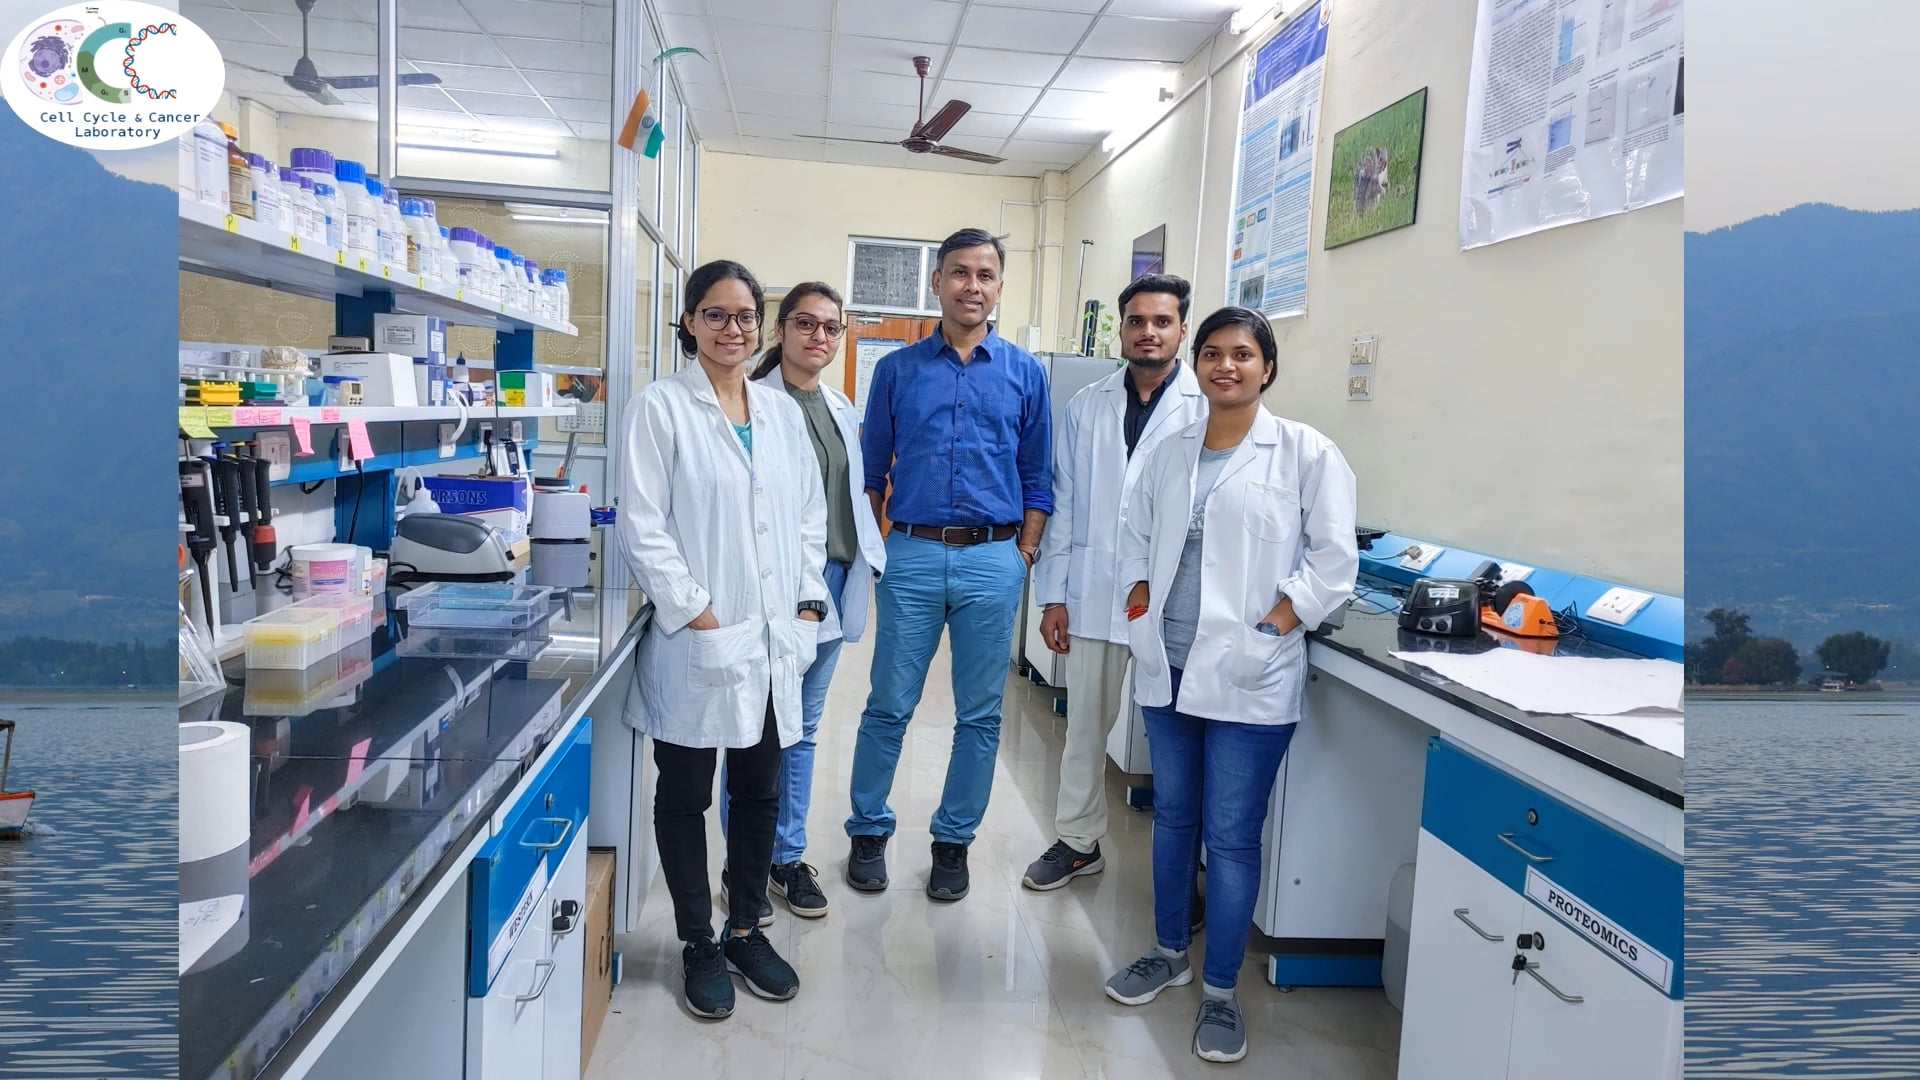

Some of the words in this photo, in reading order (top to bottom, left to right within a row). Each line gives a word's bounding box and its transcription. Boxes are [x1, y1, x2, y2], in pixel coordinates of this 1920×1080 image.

[290, 235, 299, 250] M
[430, 488, 488, 505] ARSONS
[1547, 889, 1639, 962] PROTEOMICS
